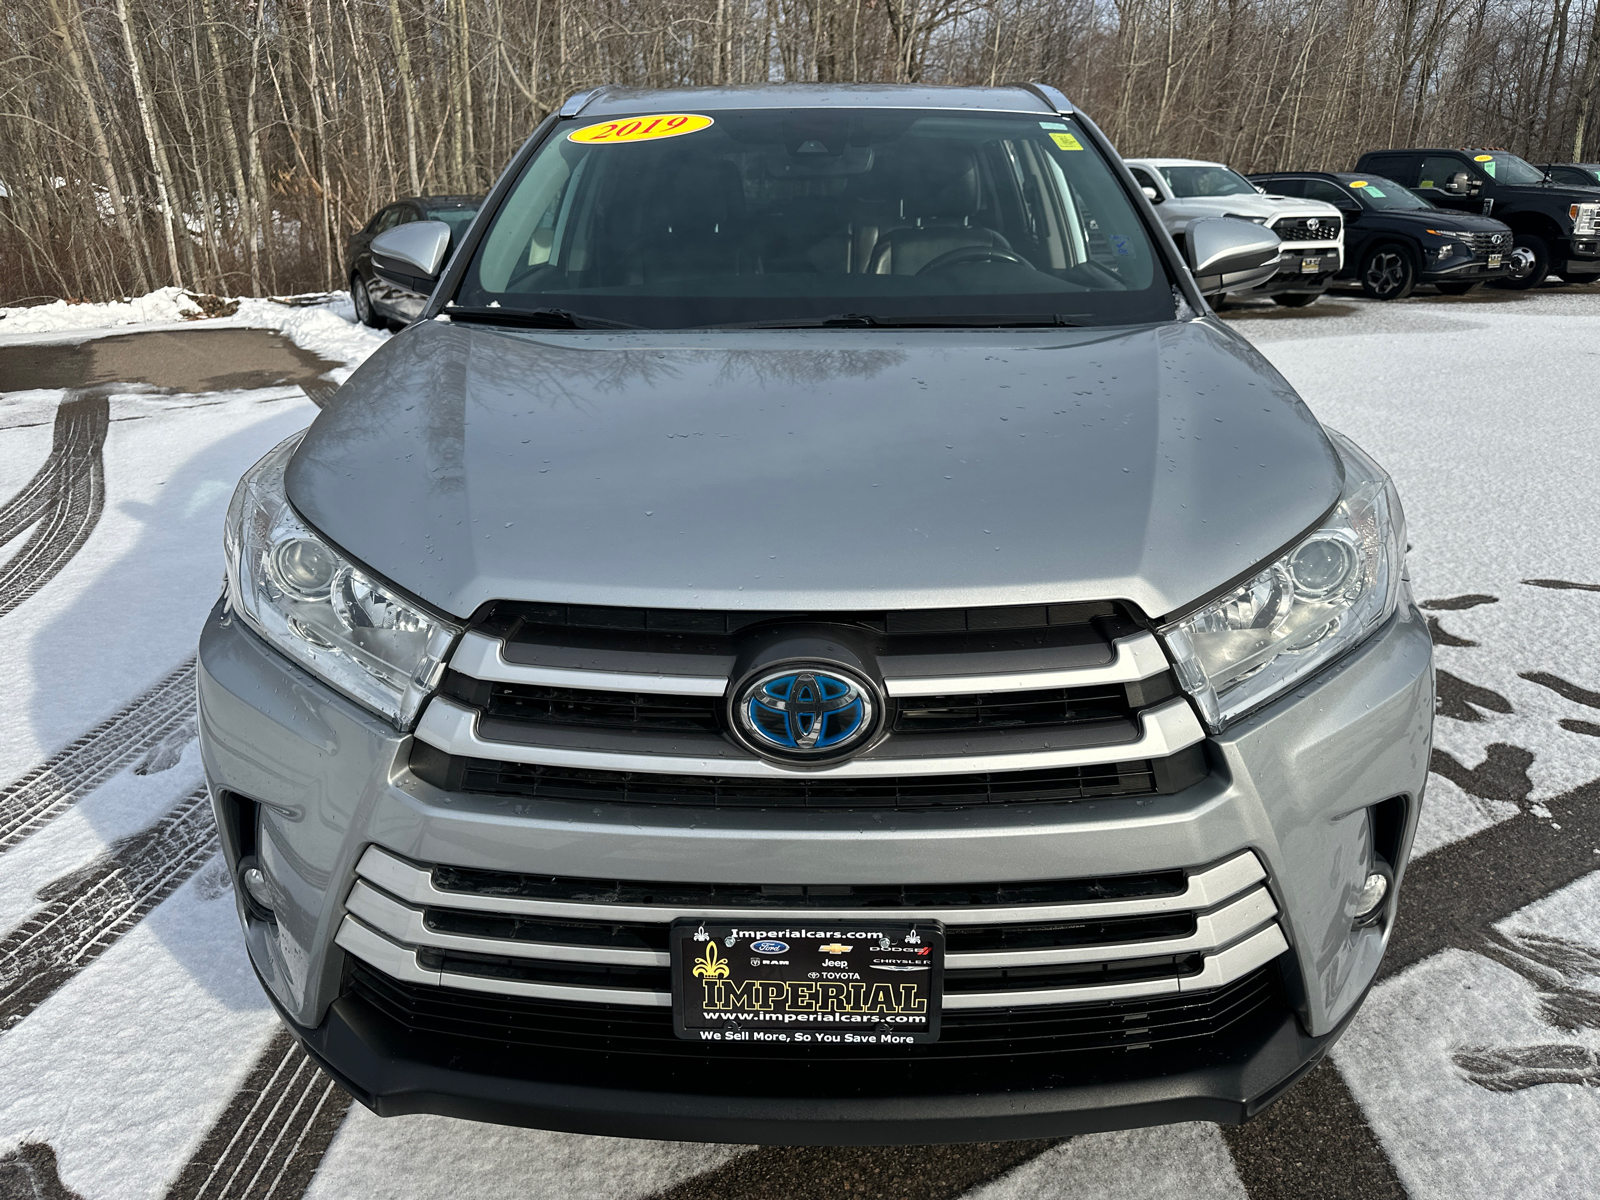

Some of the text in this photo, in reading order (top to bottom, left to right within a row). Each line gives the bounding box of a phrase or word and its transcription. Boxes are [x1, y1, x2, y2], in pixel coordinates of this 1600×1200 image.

[589, 117, 688, 140] 2019
[731, 928, 883, 940] Imperialcars.com
[759, 943, 781, 952] Ford
[822, 959, 848, 969] Jeep
[822, 972, 860, 980] TOYOTA
[703, 979, 927, 1013] IMPERIAL
[703, 1011, 926, 1023] www.imperialcars.com
[700, 1031, 914, 1044] We Sell More, So You Save More
